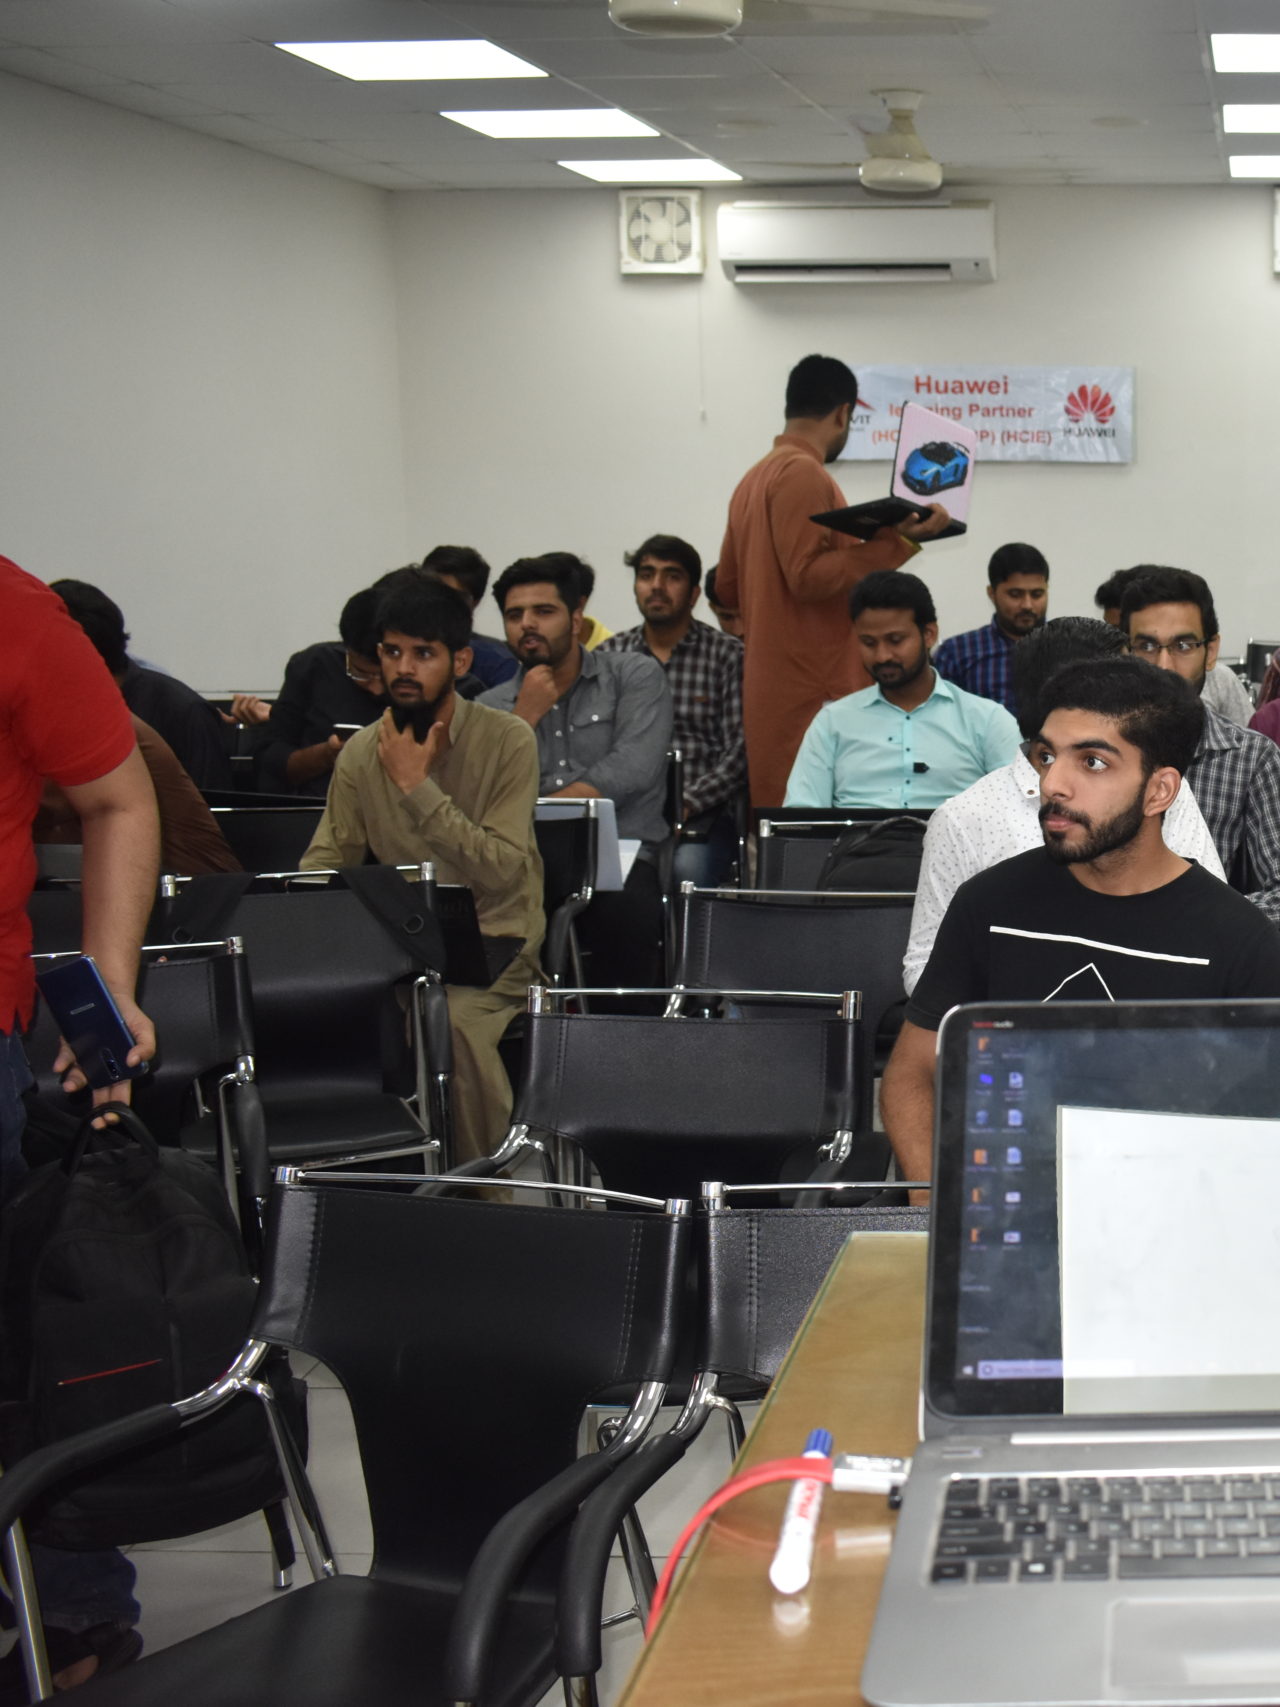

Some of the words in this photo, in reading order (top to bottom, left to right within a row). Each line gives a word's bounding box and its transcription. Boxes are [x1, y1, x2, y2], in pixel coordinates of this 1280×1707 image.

[914, 375, 1009, 395] Huawei
[968, 404, 1034, 418] Partner
[1001, 430, 1052, 446] (HCIE)
[1063, 427, 1116, 438] HUAWEI
